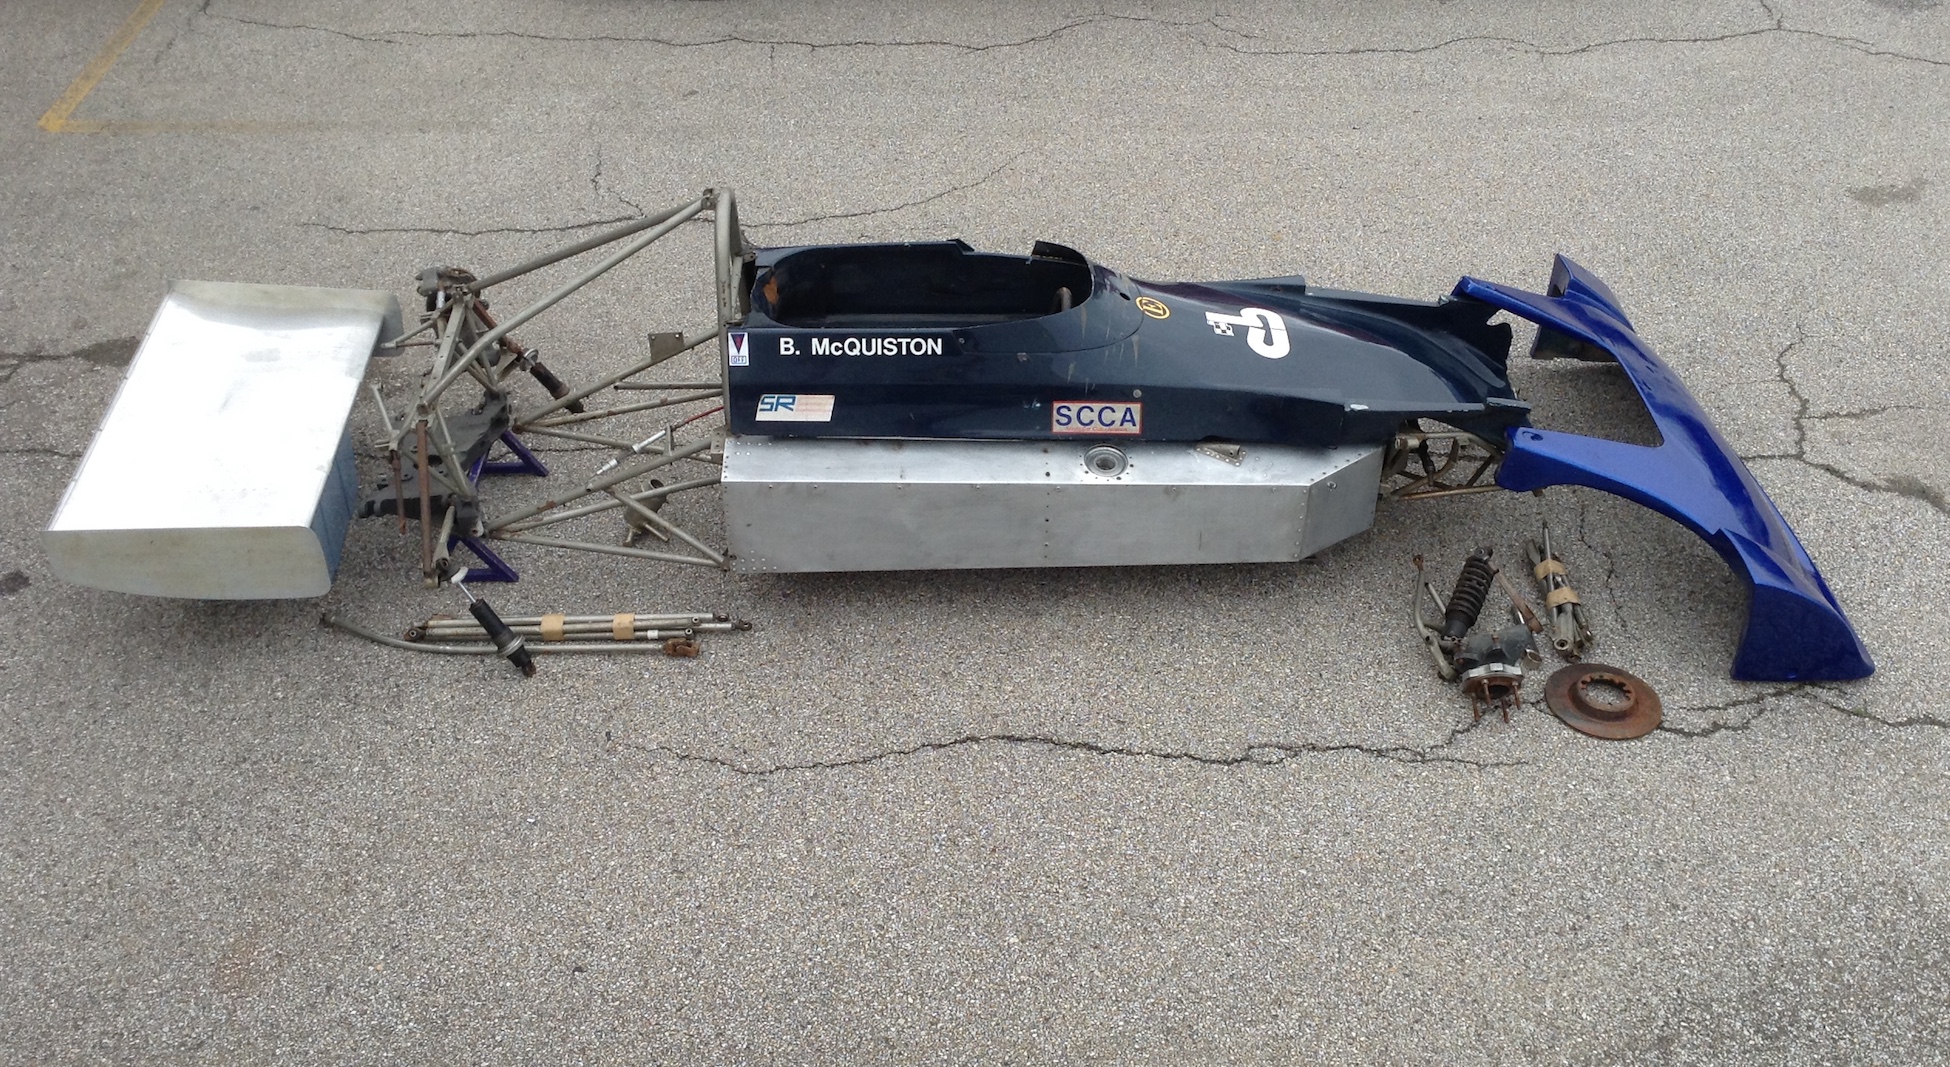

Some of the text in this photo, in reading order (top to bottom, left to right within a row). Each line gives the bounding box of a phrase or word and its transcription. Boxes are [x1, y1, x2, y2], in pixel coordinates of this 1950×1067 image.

[779, 337, 942, 356] B. McQUISTON
[759, 395, 796, 412] SR
[1055, 405, 1136, 427] SCCA
